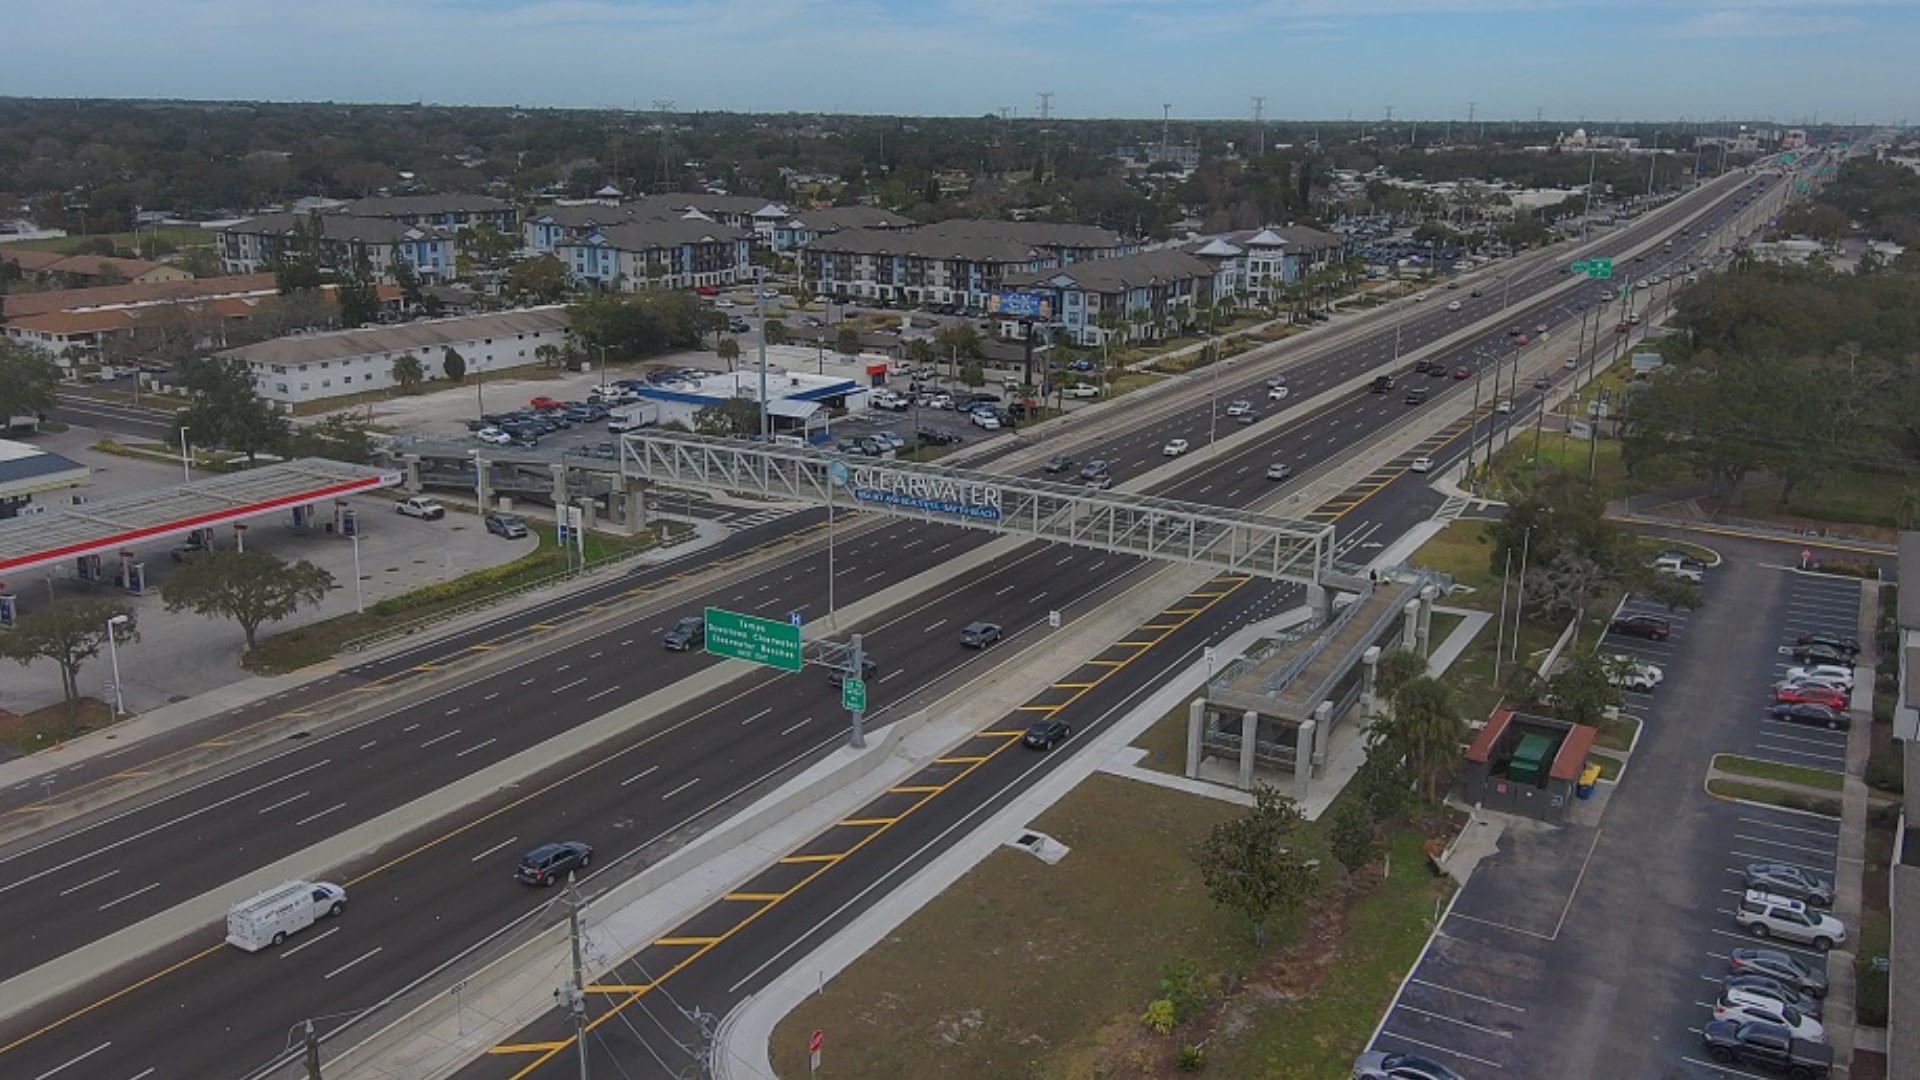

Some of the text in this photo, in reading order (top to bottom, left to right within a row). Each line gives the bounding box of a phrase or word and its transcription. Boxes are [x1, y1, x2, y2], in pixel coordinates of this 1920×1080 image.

[855, 469, 999, 507] CLEARWATER
[712, 634, 756, 650] Clearwater
[752, 633, 798, 649] Clearwater
